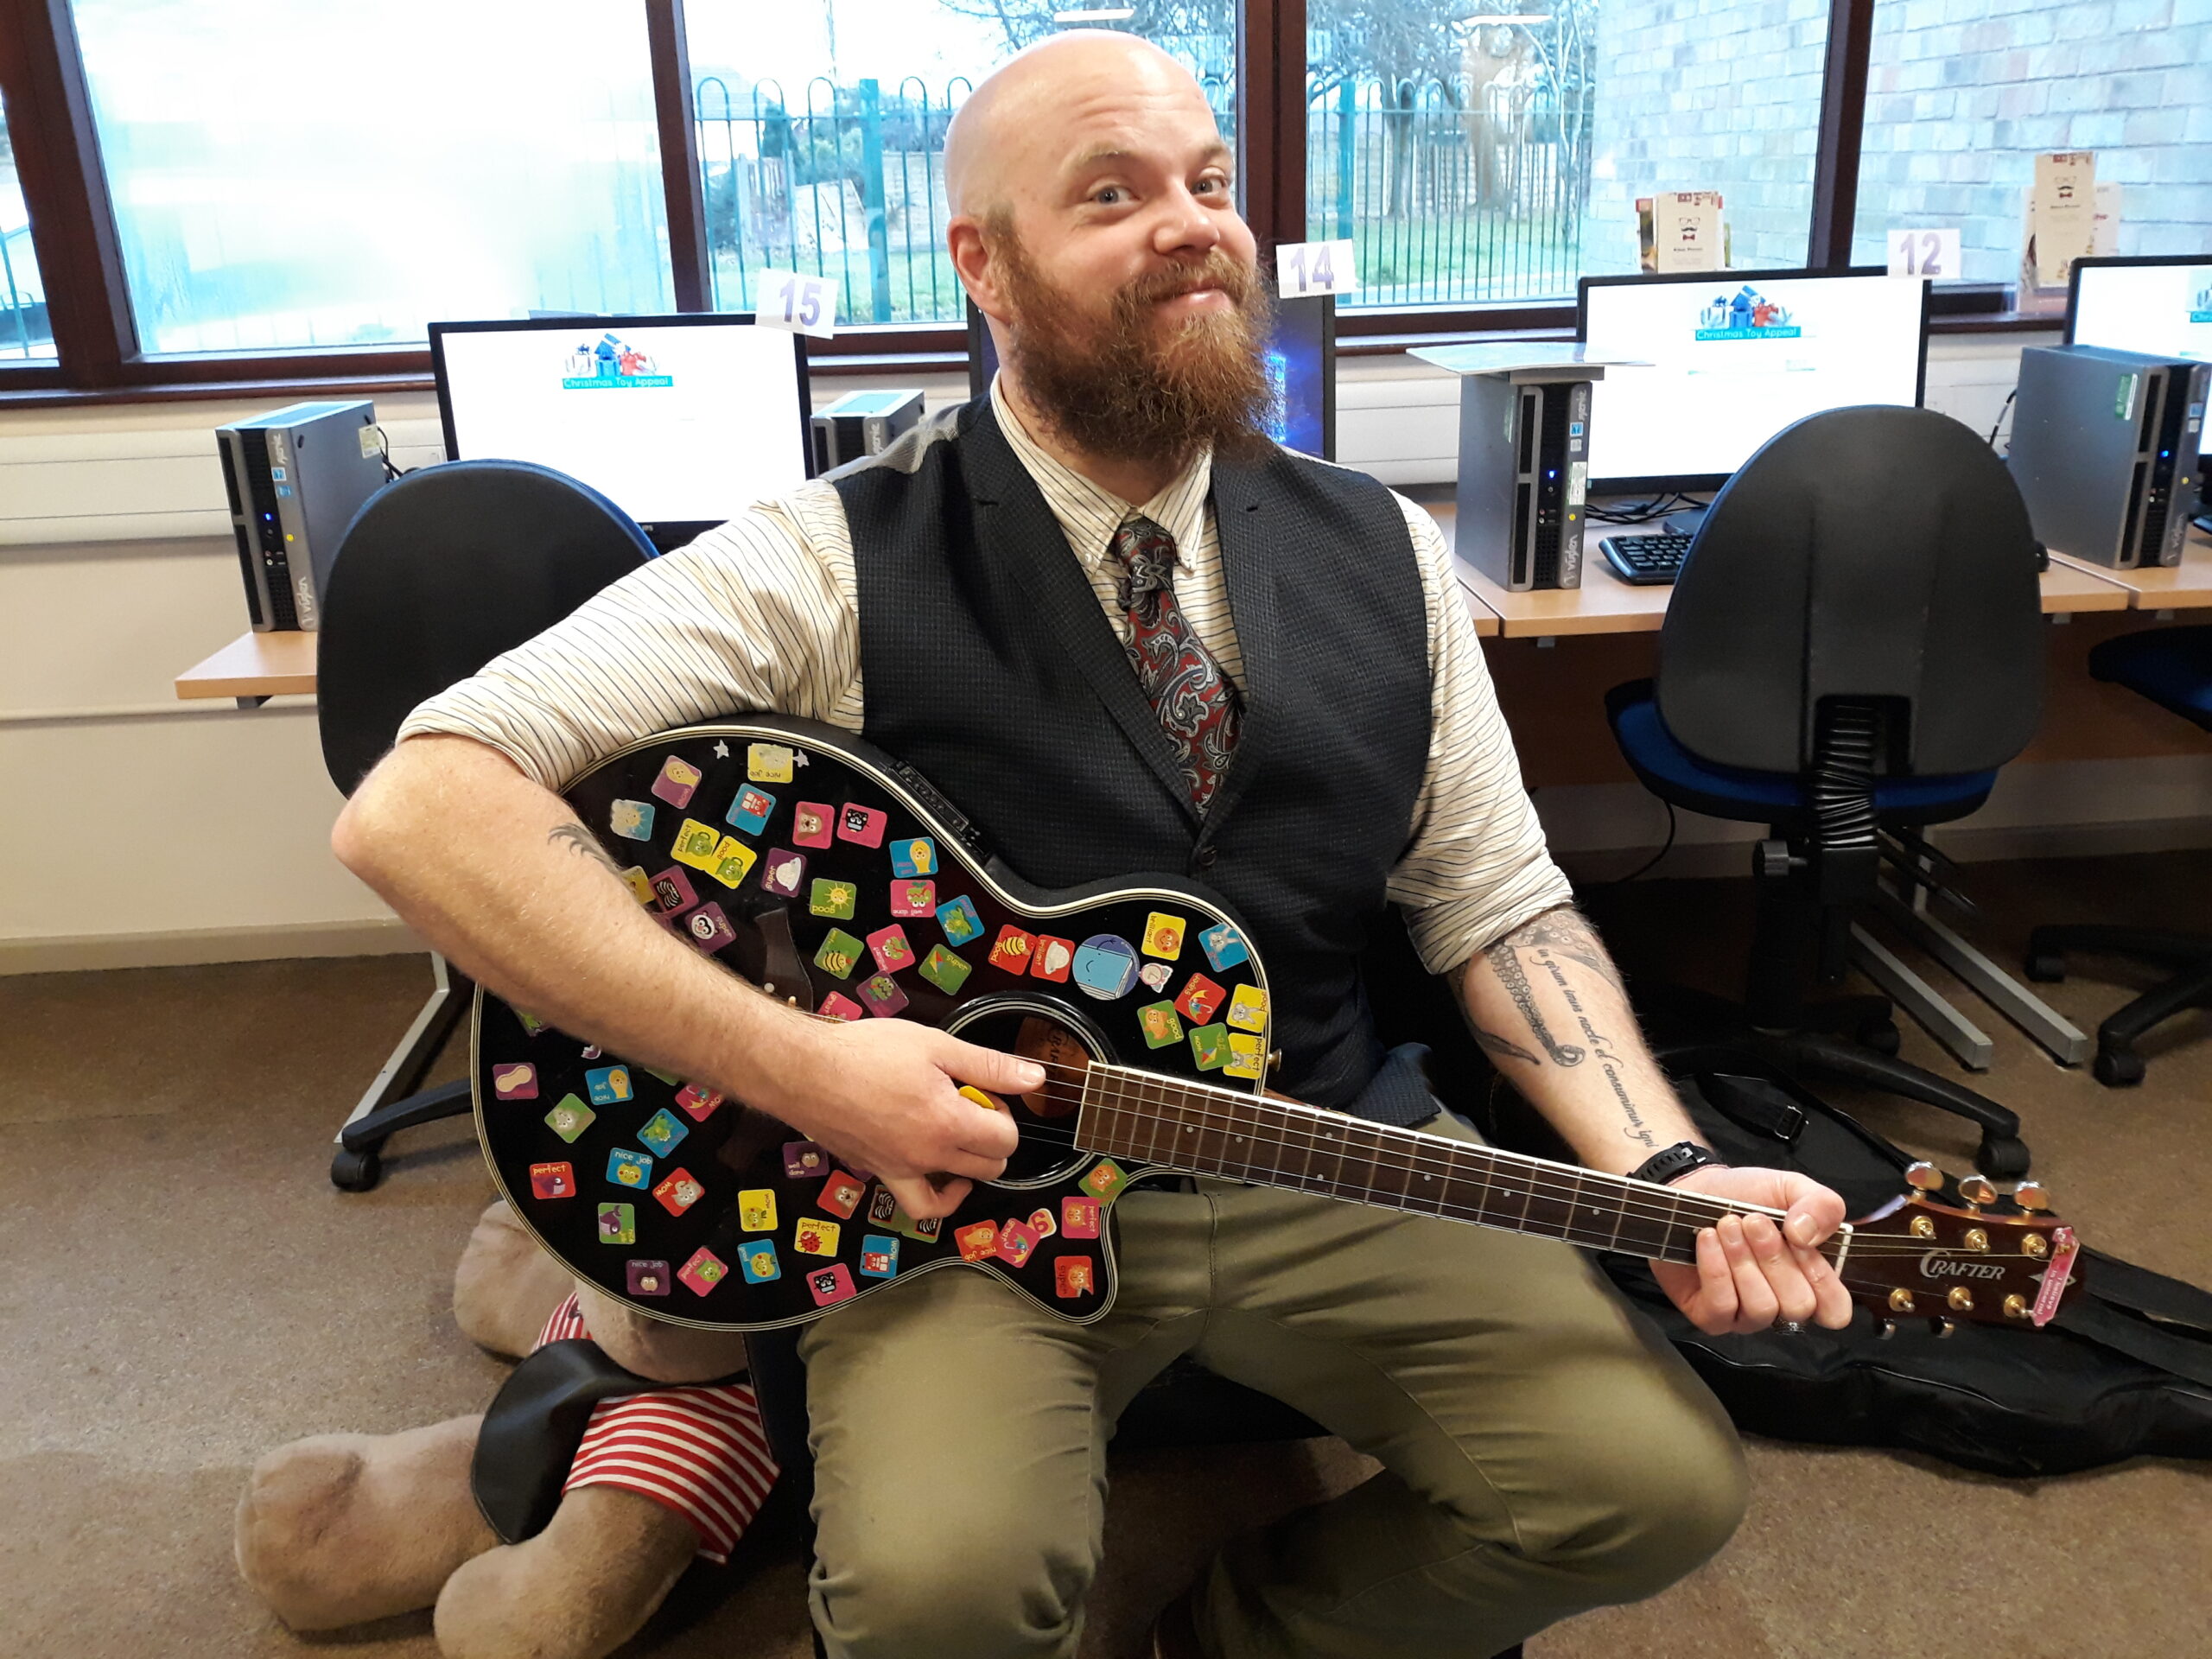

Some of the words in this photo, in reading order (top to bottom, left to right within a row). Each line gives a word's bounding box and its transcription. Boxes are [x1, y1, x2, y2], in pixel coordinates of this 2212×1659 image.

[1900, 232, 1942, 275] 12
[1290, 245, 1335, 292] 14
[779, 278, 822, 327] 15
[1696, 329, 1744, 340] Christmas
[1746, 328, 1762, 339] Toy
[1764, 327, 1796, 338] Appeal
[563, 378, 613, 388] Christmas
[615, 377, 632, 387] Toy
[635, 377, 668, 387] Appeal
[677, 824, 692, 852] perfect
[716, 841, 731, 861] good
[765, 865, 776, 891] super
[812, 905, 836, 914] good
[715, 916, 733, 938] super
[1146, 915, 1157, 944] brilliant
[946, 954, 969, 971] super
[990, 941, 1002, 963] good
[1036, 939, 1047, 966] brilliant
[1185, 976, 1200, 995] super
[1166, 1017, 1182, 1039] good
[1252, 1037, 1263, 1071] perfect
[614, 1151, 633, 1160] nice
[636, 1154, 652, 1165] job
[532, 1164, 566, 1176] perfect
[801, 1222, 836, 1232] perfect
[1088, 1205, 1097, 1232] perfect
[964, 1251, 978, 1262] job
[980, 1247, 997, 1256] nice
[650, 1261, 664, 1269] job
[1920, 1249, 2005, 1281] CRAFTER
